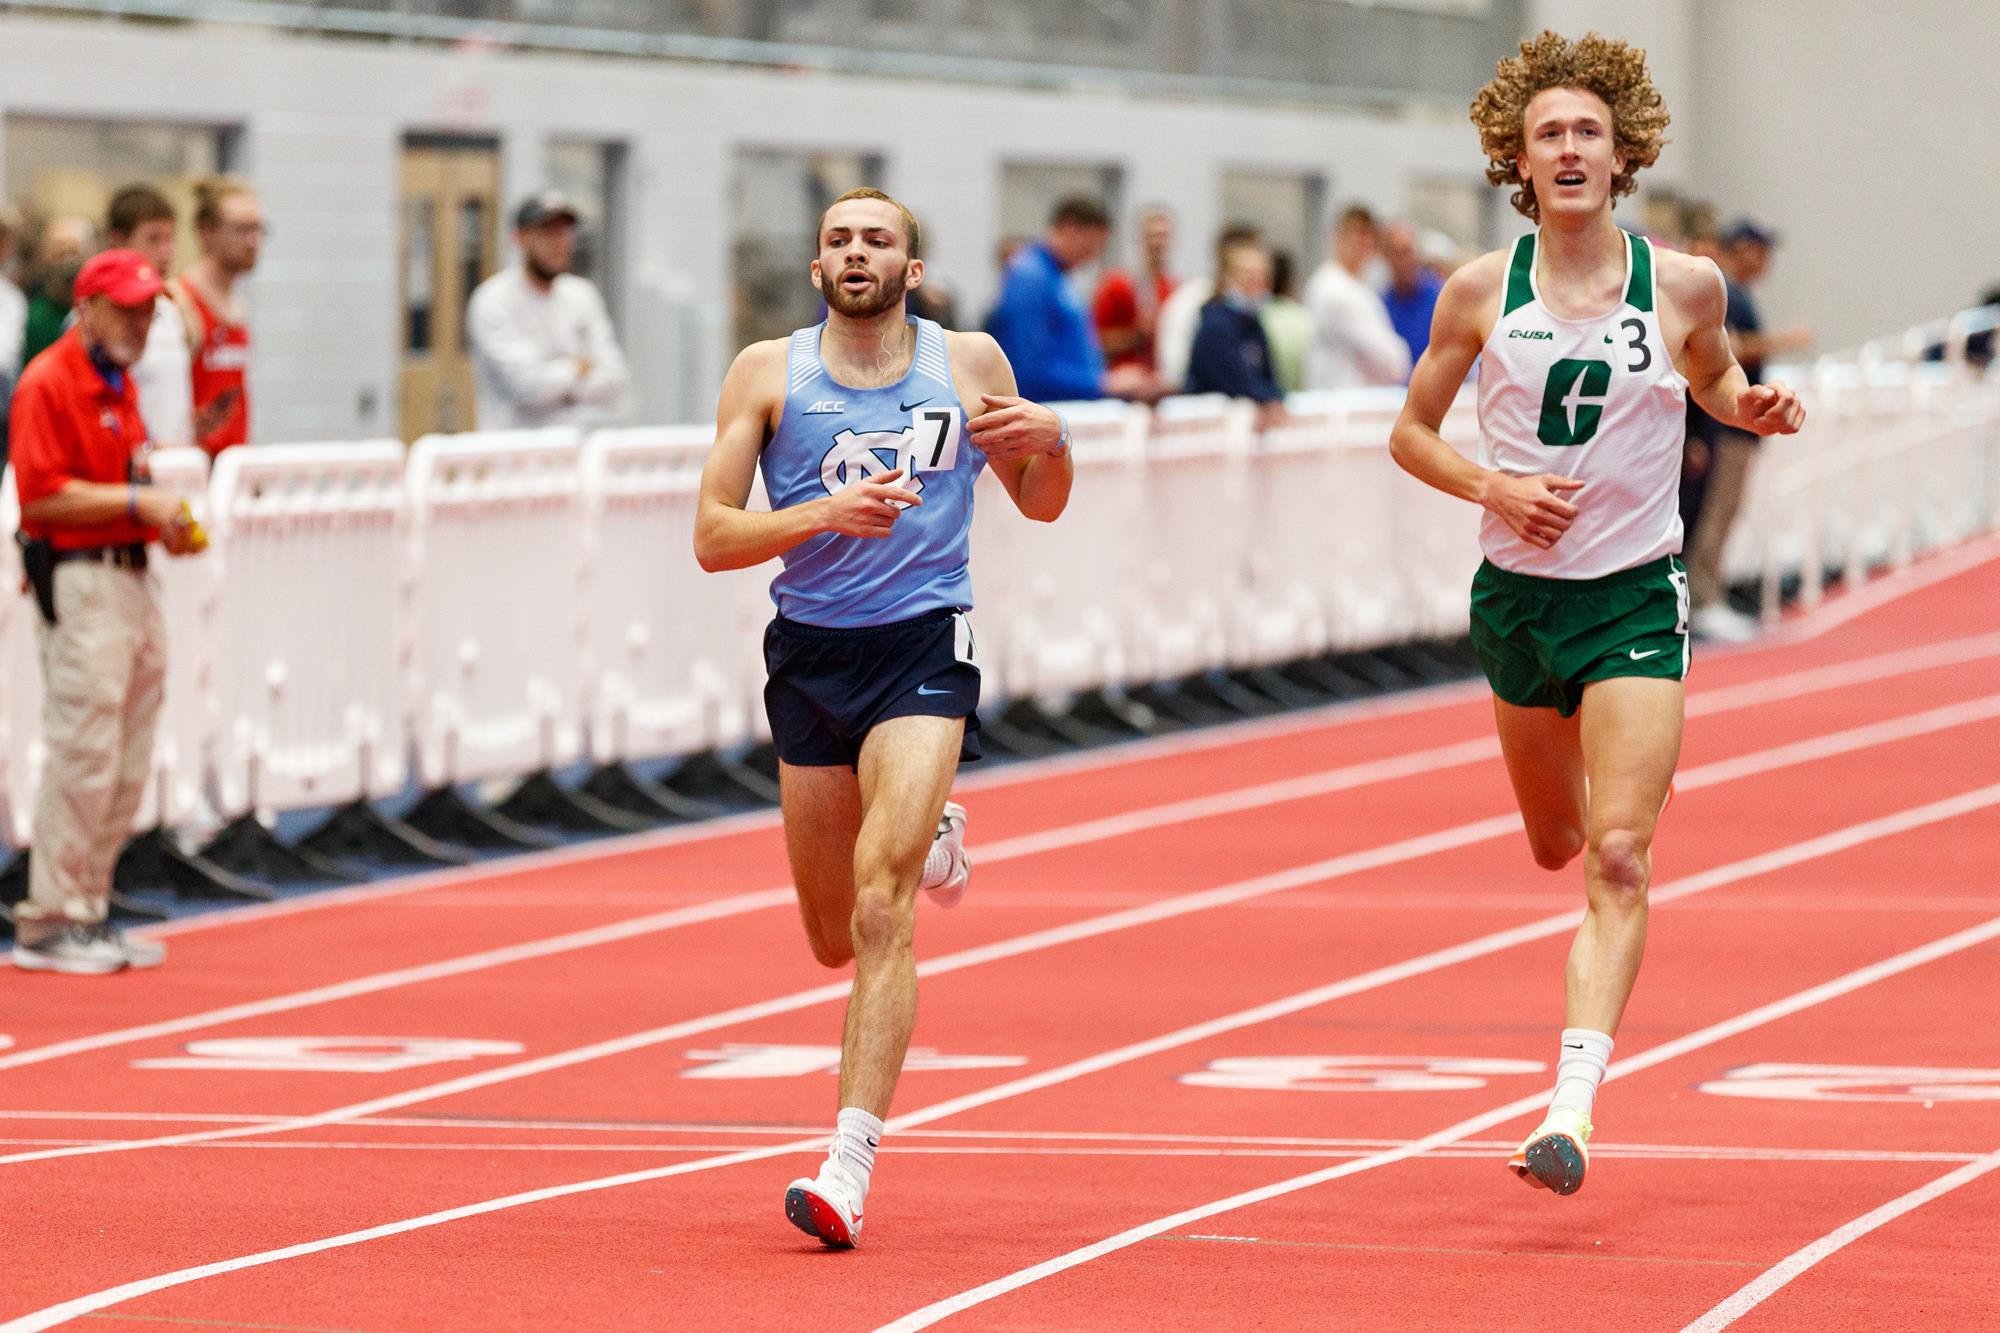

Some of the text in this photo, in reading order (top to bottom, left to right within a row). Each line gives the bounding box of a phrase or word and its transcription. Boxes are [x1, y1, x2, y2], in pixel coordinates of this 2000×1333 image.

[1620, 318, 1651, 372] 3
[804, 400, 846, 413] ACC
[924, 412, 951, 467] 7
